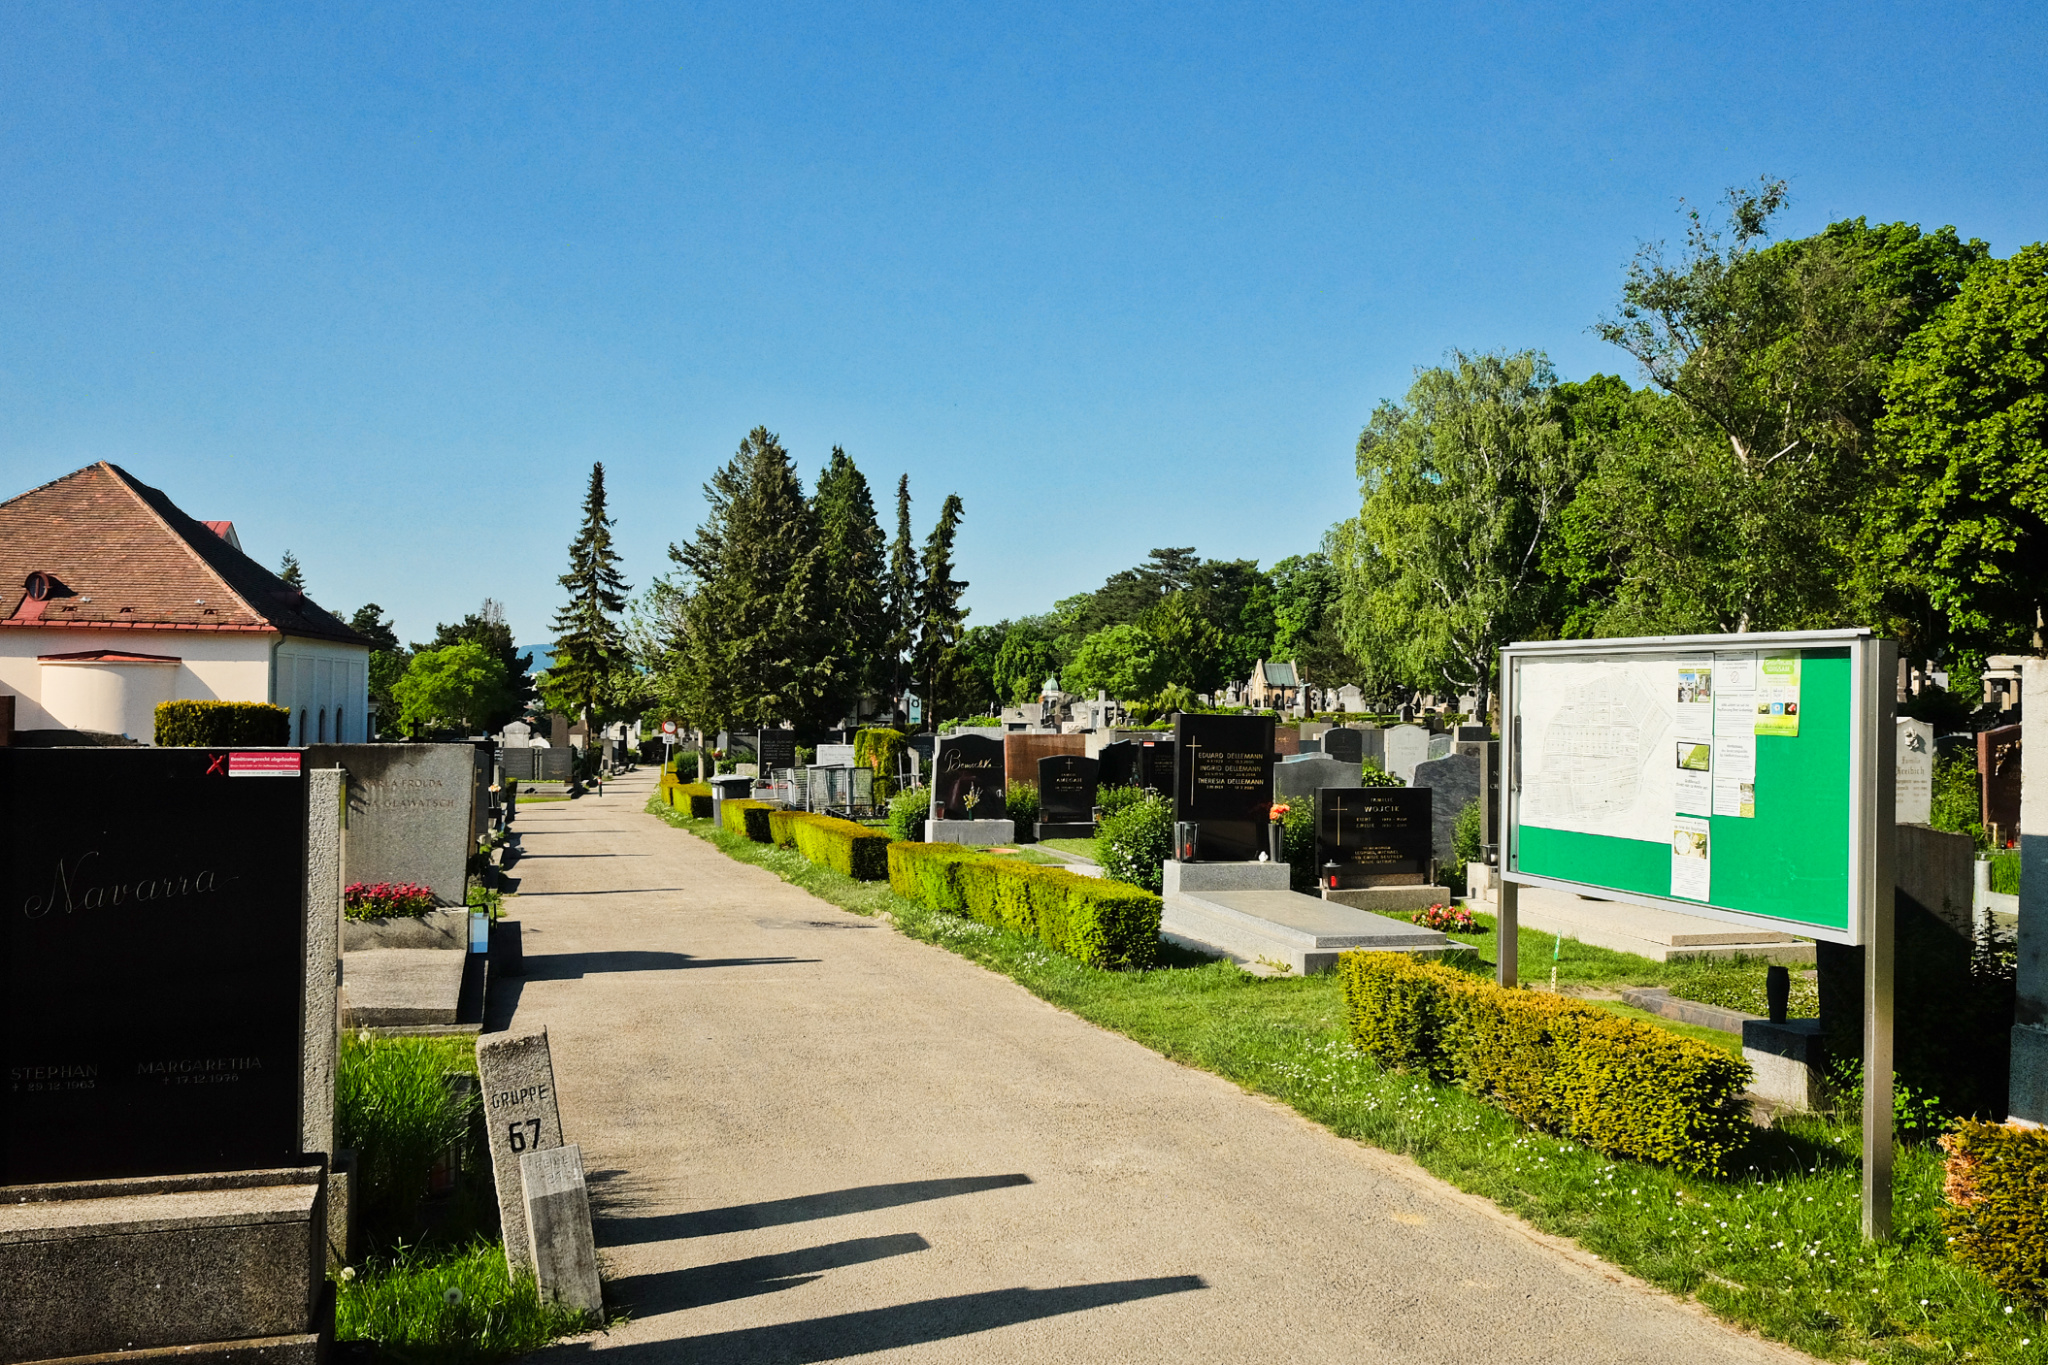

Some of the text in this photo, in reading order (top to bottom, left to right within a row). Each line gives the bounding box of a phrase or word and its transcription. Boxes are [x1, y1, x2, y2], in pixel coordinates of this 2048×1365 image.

[1226, 752, 1264, 760] DELLEMANN
[384, 799, 455, 808] GLAWATSCH
[24, 851, 239, 919] Navarra
[10, 1063, 98, 1081] STEPHAN
[137, 1057, 263, 1075] MARGARETHA
[492, 1084, 549, 1109] GRUPPE
[509, 1118, 541, 1154] 67
